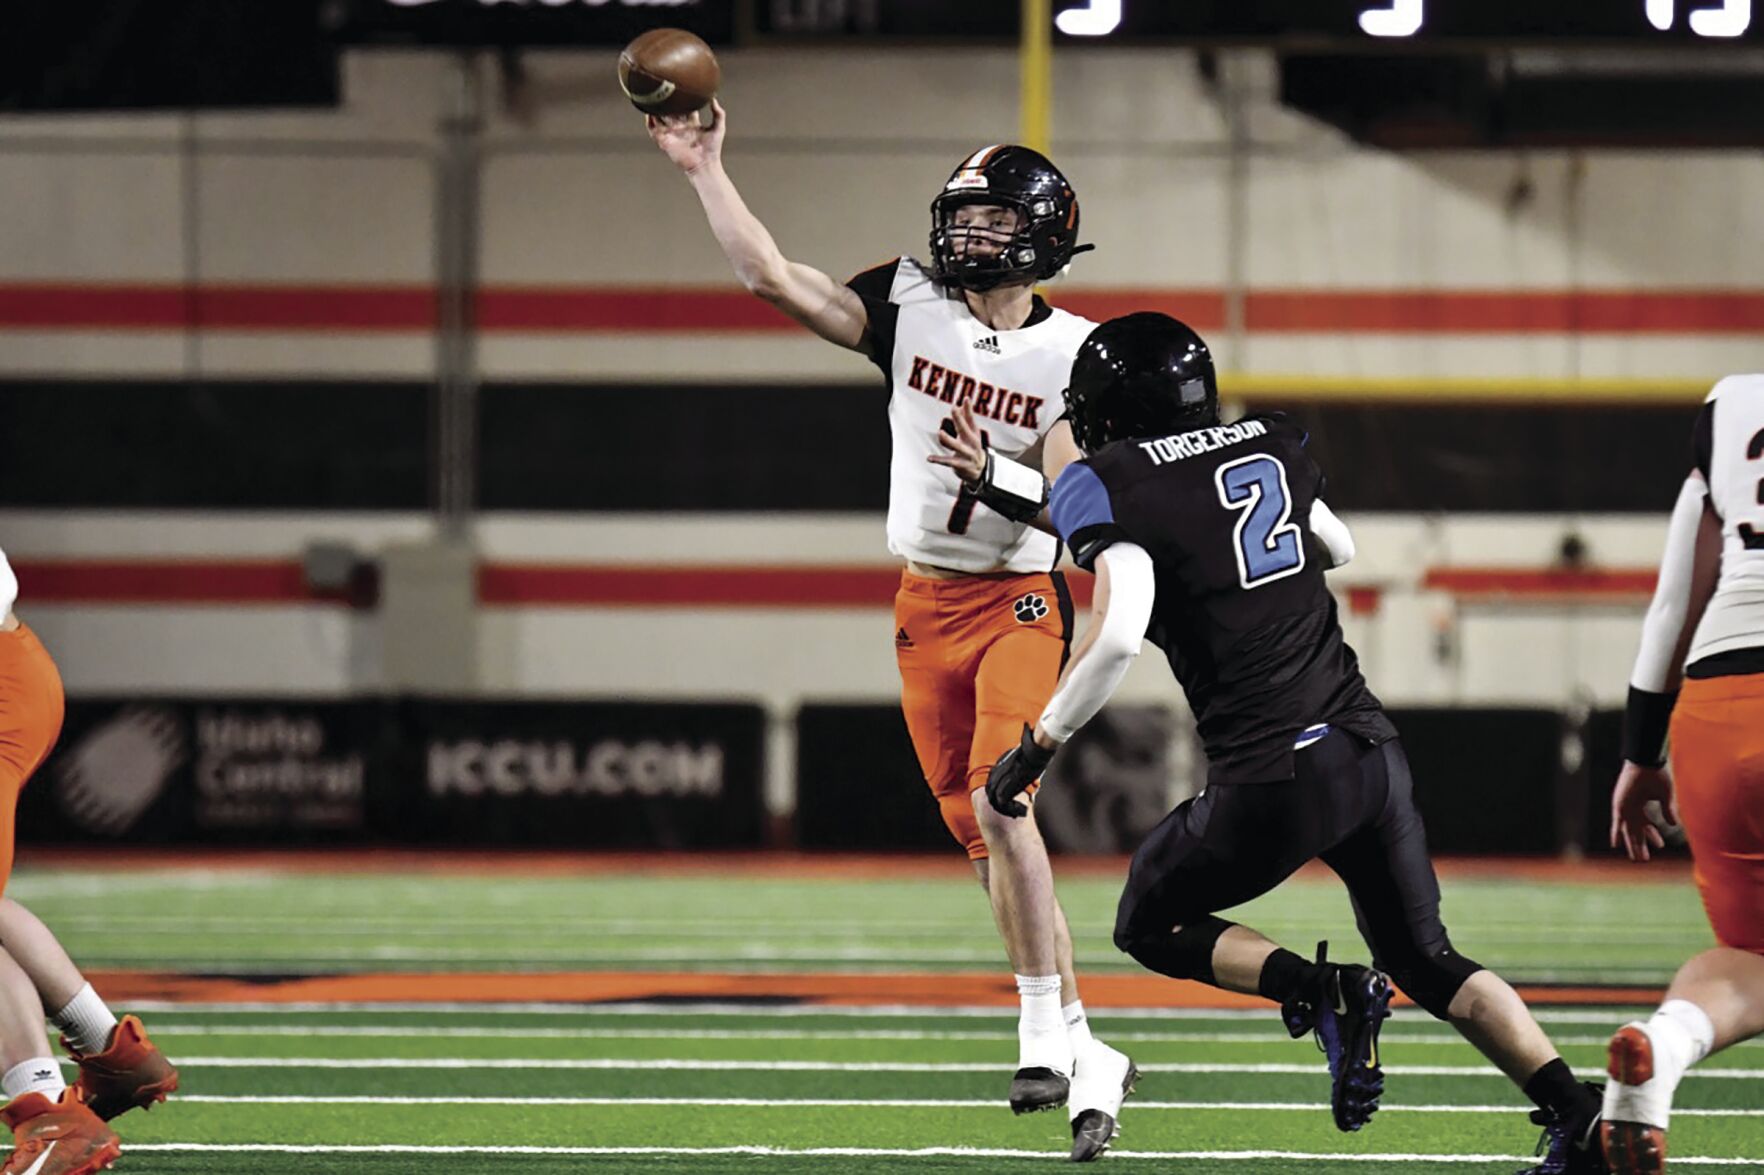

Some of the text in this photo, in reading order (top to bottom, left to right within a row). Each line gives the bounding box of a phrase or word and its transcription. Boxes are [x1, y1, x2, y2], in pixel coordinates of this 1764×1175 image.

[907, 355, 1044, 430] KENDRICK
[1139, 419, 1268, 466] TORGERSON
[1215, 453, 1305, 590] 2
[427, 739, 724, 795] ICCU.COM
